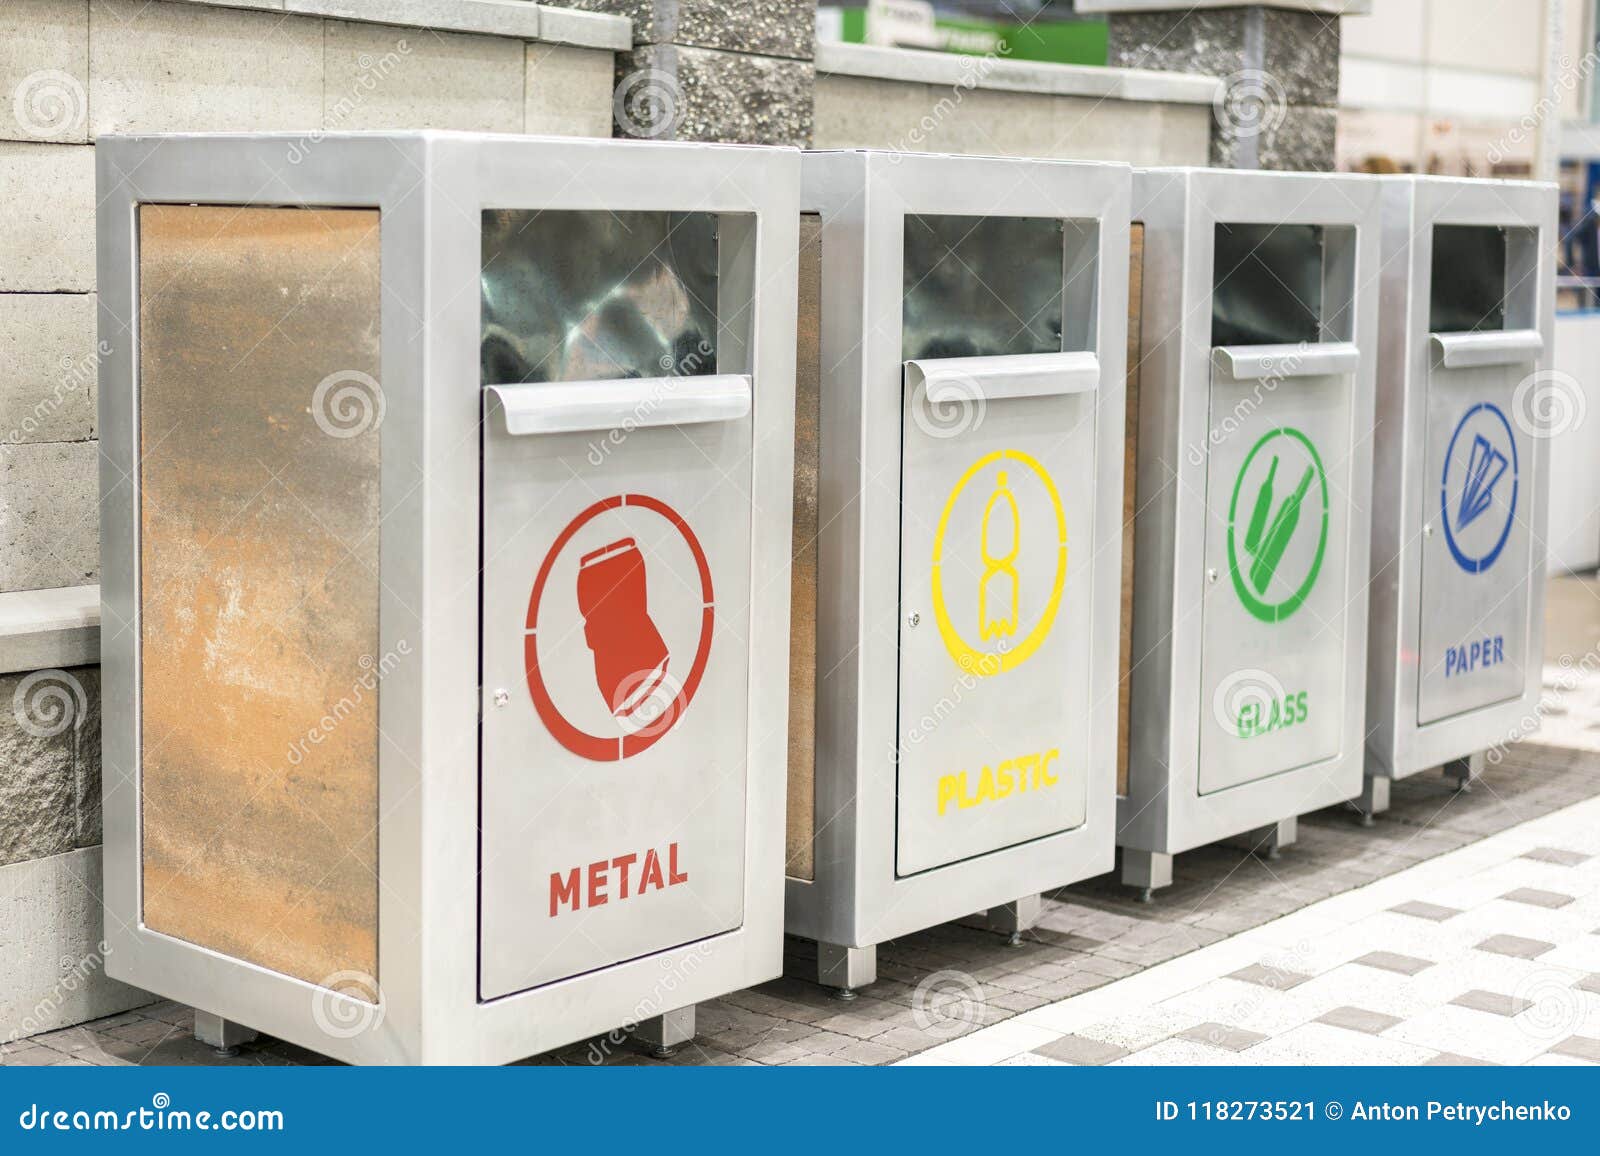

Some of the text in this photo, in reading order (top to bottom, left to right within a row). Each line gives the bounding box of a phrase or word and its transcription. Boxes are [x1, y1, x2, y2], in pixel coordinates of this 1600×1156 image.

[1444, 635, 1504, 678] PAPER
[1237, 691, 1308, 738] GLASS
[937, 748, 1059, 816] PLASTIC
[549, 842, 688, 917] METAL
